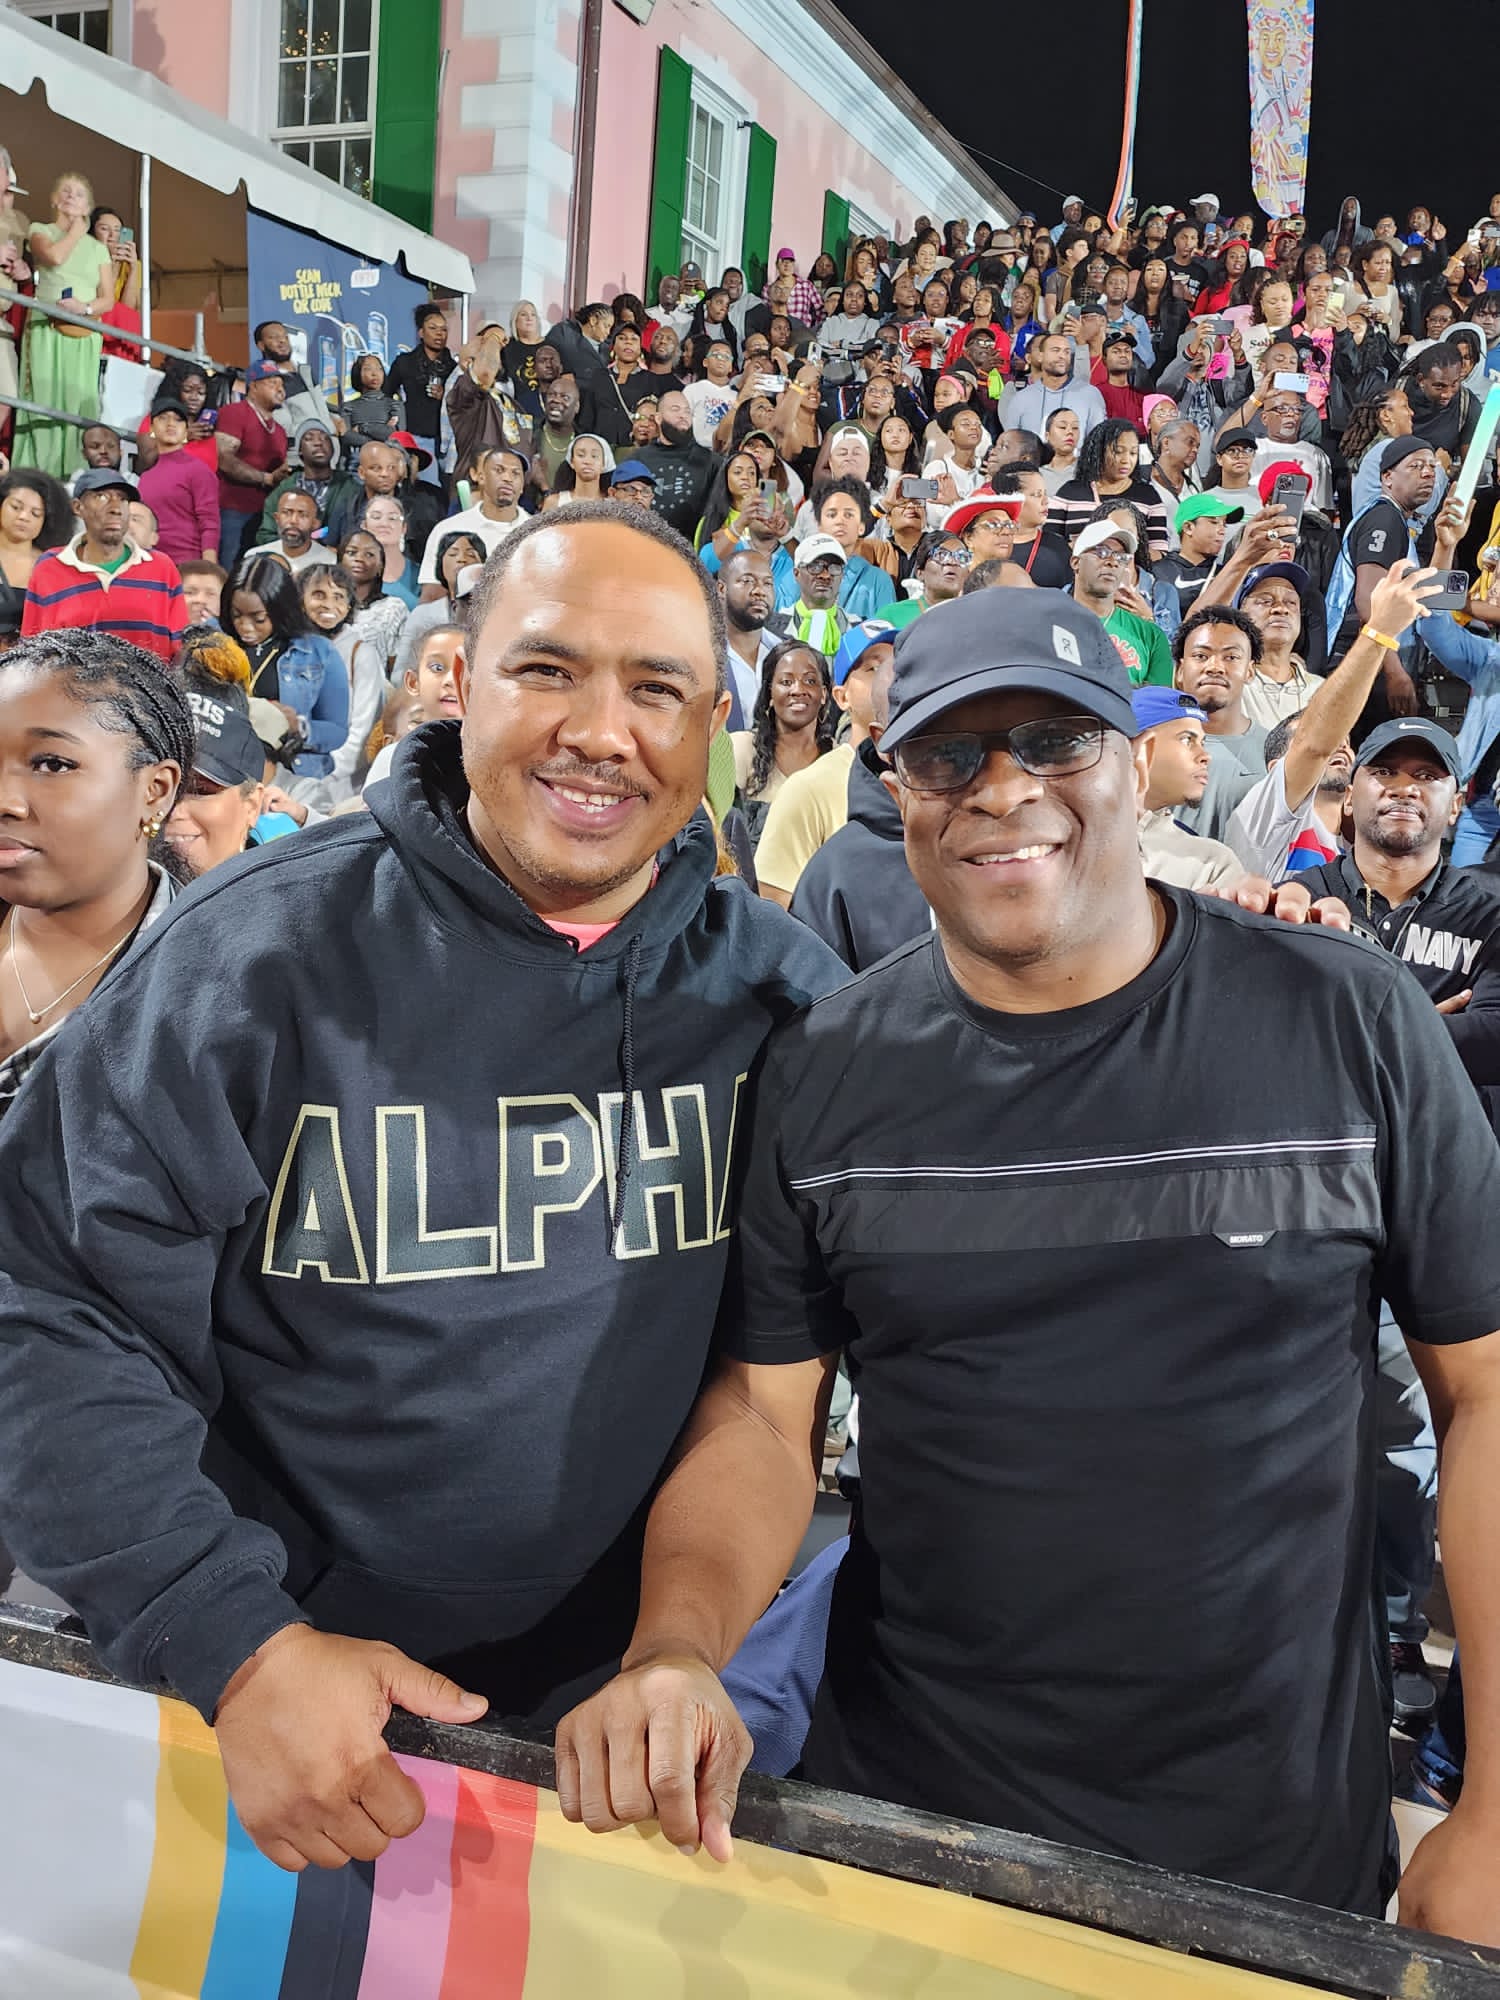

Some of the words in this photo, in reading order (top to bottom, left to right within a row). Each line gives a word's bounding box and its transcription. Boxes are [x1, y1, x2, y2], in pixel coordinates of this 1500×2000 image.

[1368, 530, 1387, 553] 3
[186, 692, 225, 725] RIS
[1401, 922, 1482, 975] NAVY
[261, 1071, 748, 1284] ALPH
